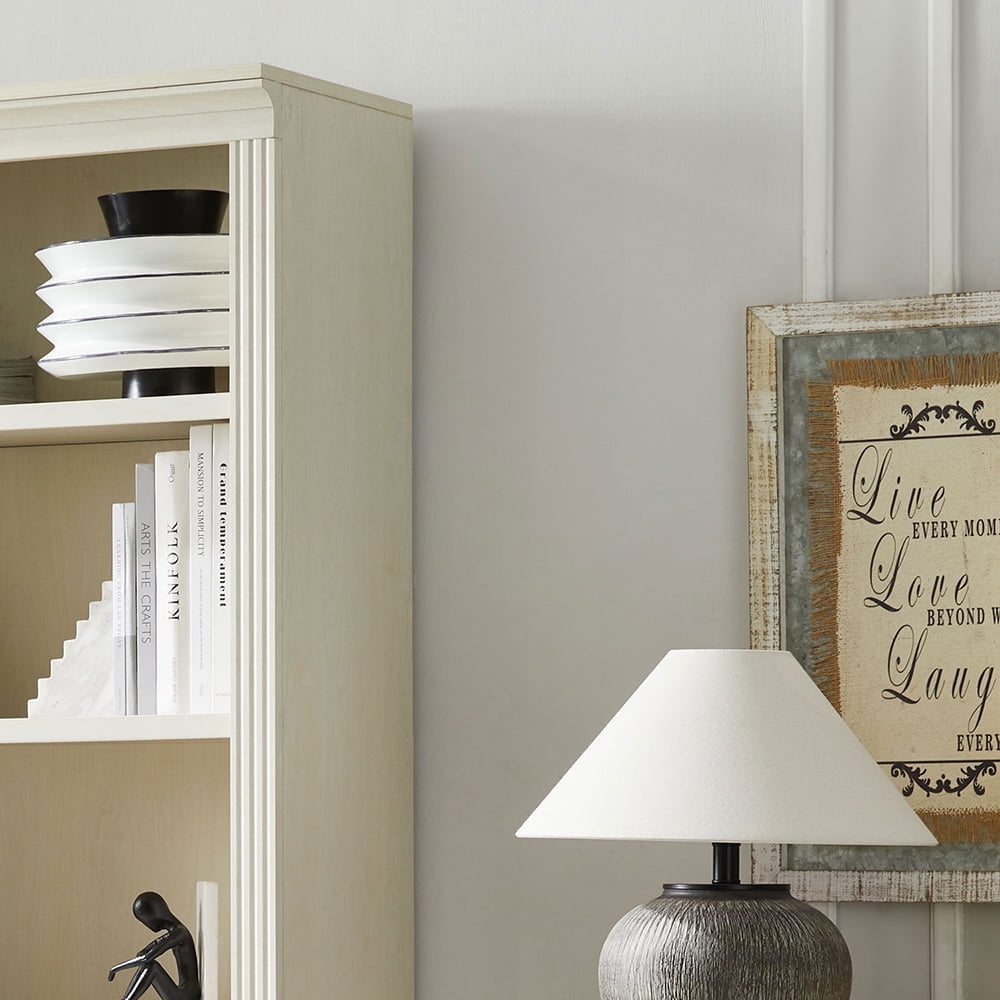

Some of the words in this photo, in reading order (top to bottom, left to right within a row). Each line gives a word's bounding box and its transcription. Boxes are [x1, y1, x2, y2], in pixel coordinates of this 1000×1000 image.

[197, 452, 205, 492] MANSION
[219, 463, 228, 506] Grand
[846, 444, 945, 525] Live
[197, 495, 205, 508] TO
[140, 522, 151, 555] ARTS
[197, 509, 205, 557] SIMPLICITY
[912, 520, 958, 539] EVERY
[964, 518, 1000, 537] MOM
[140, 561, 151, 588] THE
[167, 521, 180, 621] KINFOLK
[219, 511, 228, 607] temperament
[863, 532, 969, 613] Love
[140, 594, 152, 644] CRAFTS
[927, 607, 985, 626] BEYOND
[956, 733, 1000, 752] EVERY
